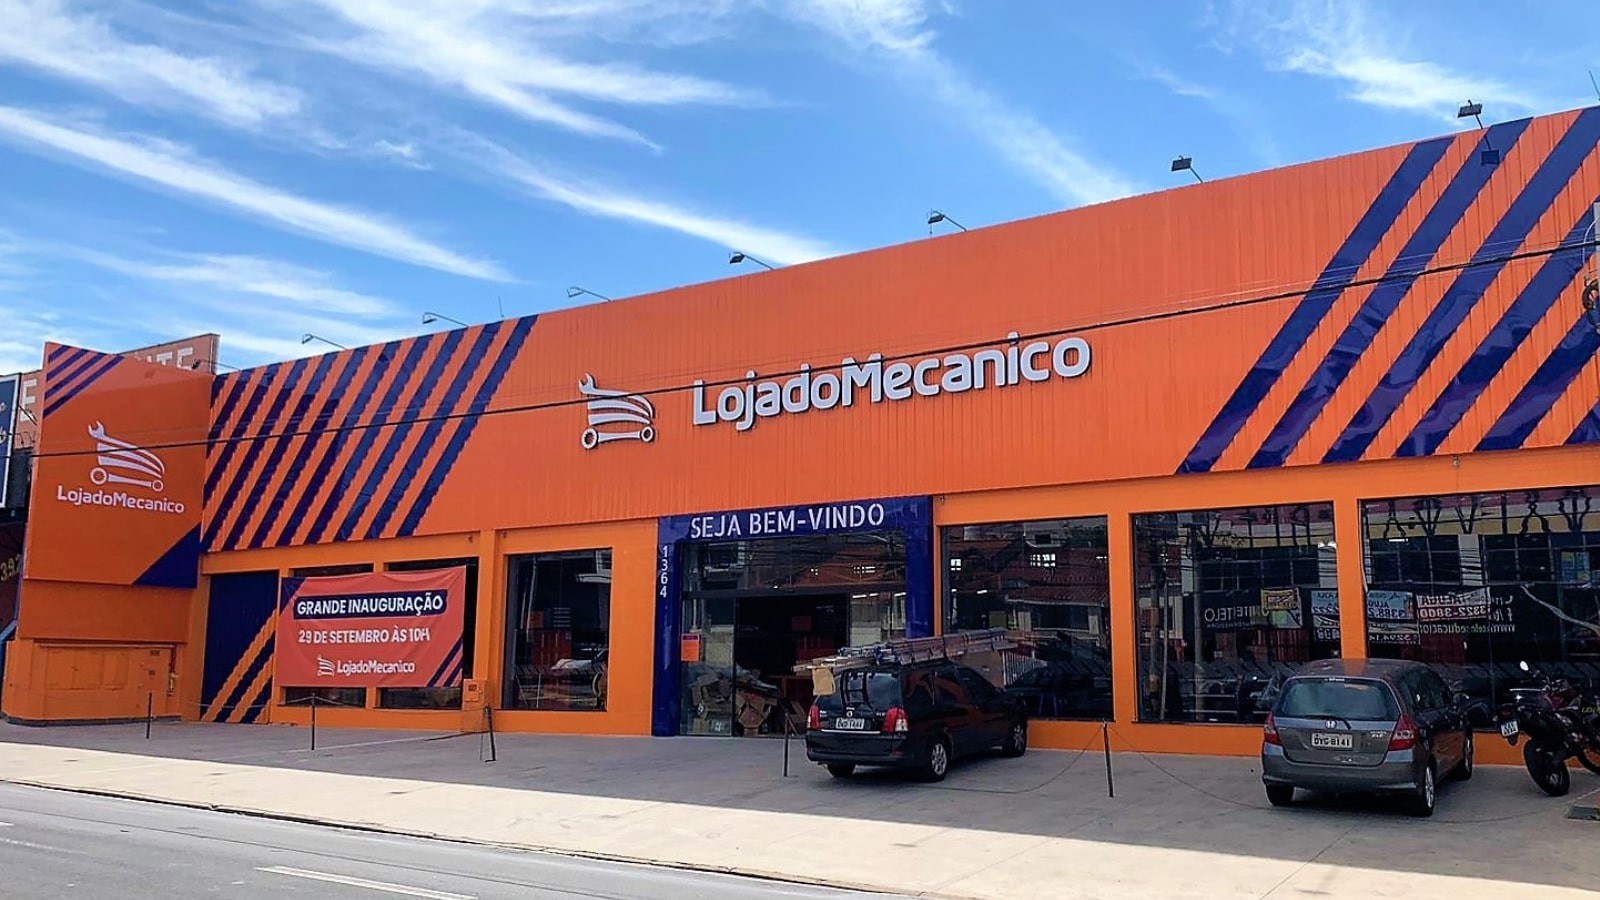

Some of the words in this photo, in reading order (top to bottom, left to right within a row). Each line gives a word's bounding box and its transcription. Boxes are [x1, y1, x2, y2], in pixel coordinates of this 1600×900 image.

[692, 331, 1092, 431] LojadoMecanico
[56, 485, 185, 514] LojadoMecanico
[690, 514, 742, 539] SEJA
[749, 503, 885, 535] BEM-VINDO
[297, 598, 347, 616] GRANDE
[348, 592, 444, 616] INAUGURAÇÃO
[298, 630, 313, 644] 29
[313, 629, 328, 644] DE
[329, 628, 389, 644] SETEMBRO
[391, 625, 407, 643] ÀS
[408, 627, 431, 643] 10H
[337, 659, 416, 675] LojadoMecanico
